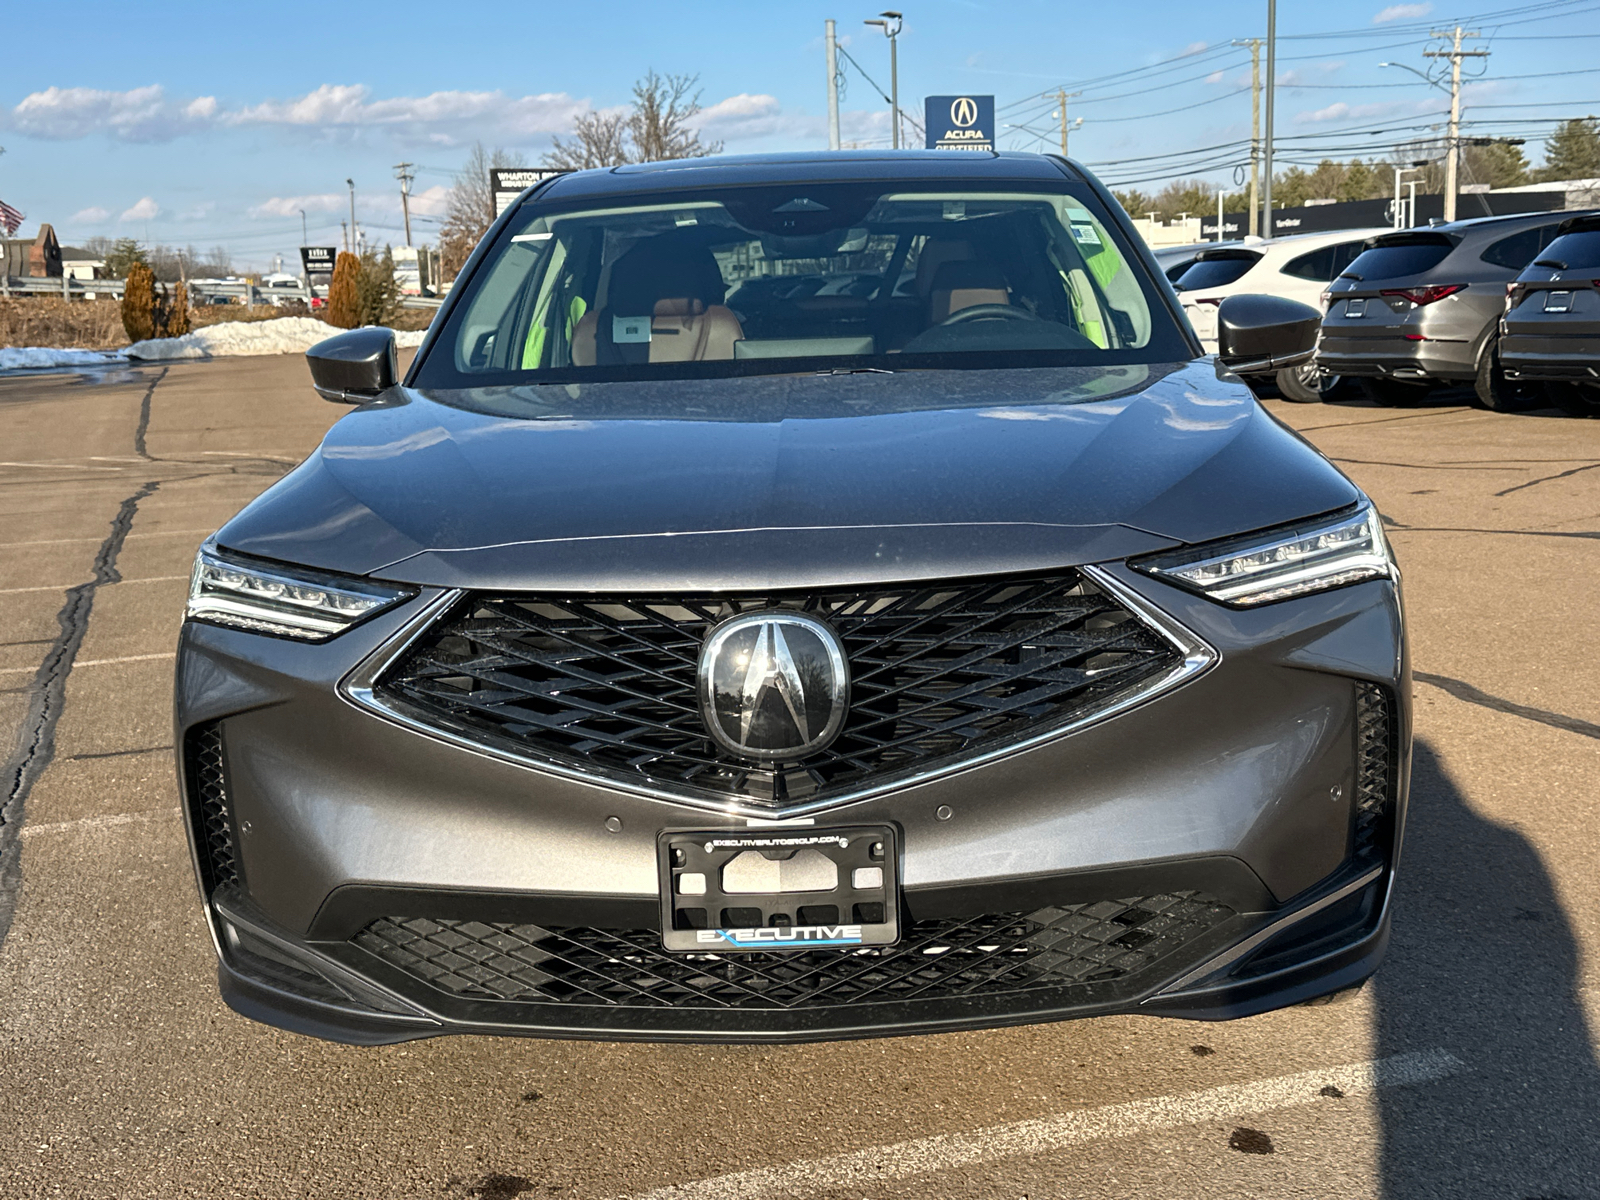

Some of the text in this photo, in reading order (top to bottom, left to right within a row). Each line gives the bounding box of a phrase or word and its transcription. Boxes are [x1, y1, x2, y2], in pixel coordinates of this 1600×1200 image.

[944, 130, 984, 139] ACURA
[497, 172, 540, 181] WHARTON
[713, 836, 839, 846] EXECUTIVEAUTOGROUP.COM
[697, 925, 862, 944] EXECUTIVE
